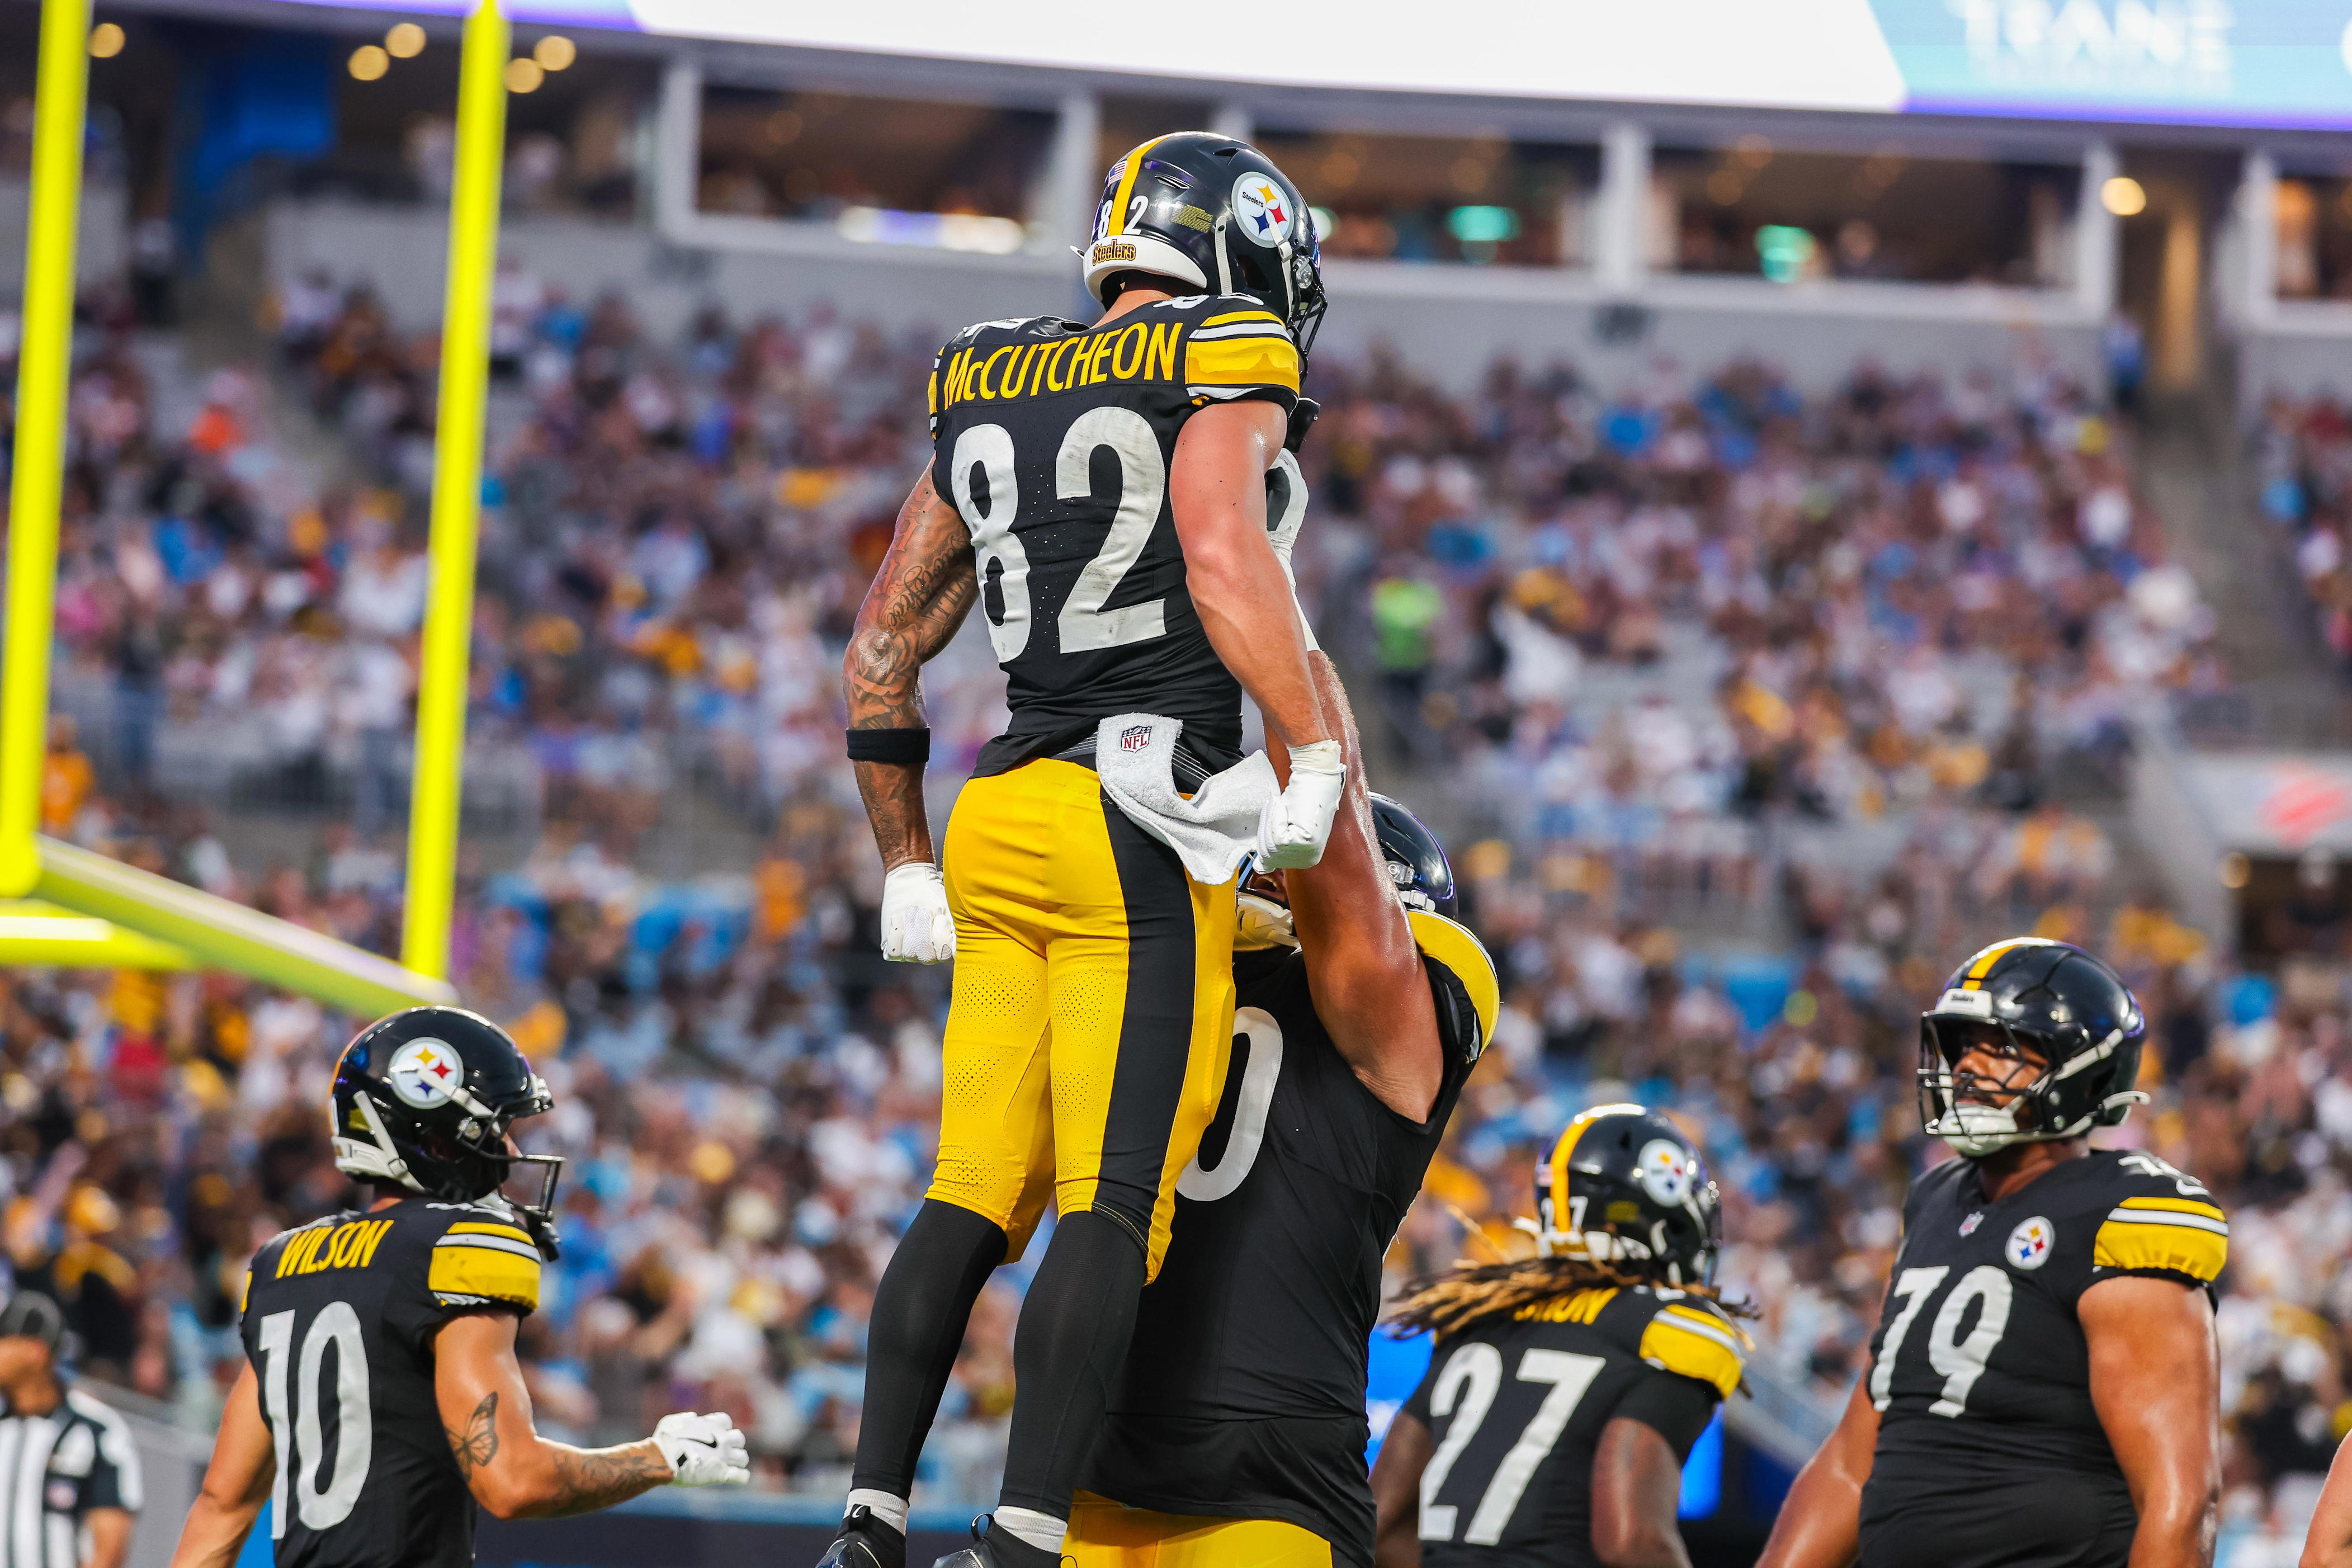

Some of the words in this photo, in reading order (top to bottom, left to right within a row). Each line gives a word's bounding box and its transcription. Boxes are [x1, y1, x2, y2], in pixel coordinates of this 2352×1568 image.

[1241, 191, 1264, 208] Steelers
[1093, 239, 1136, 266] Steelers
[943, 322, 1183, 411] McCUTCHEON
[951, 406, 1167, 663] 82
[1123, 734, 1147, 749] NFL
[276, 1219, 394, 1279] WILSON
[1871, 1265, 2013, 1418] 79
[259, 1301, 372, 1540] 10
[1418, 1342, 1607, 1547] 27
